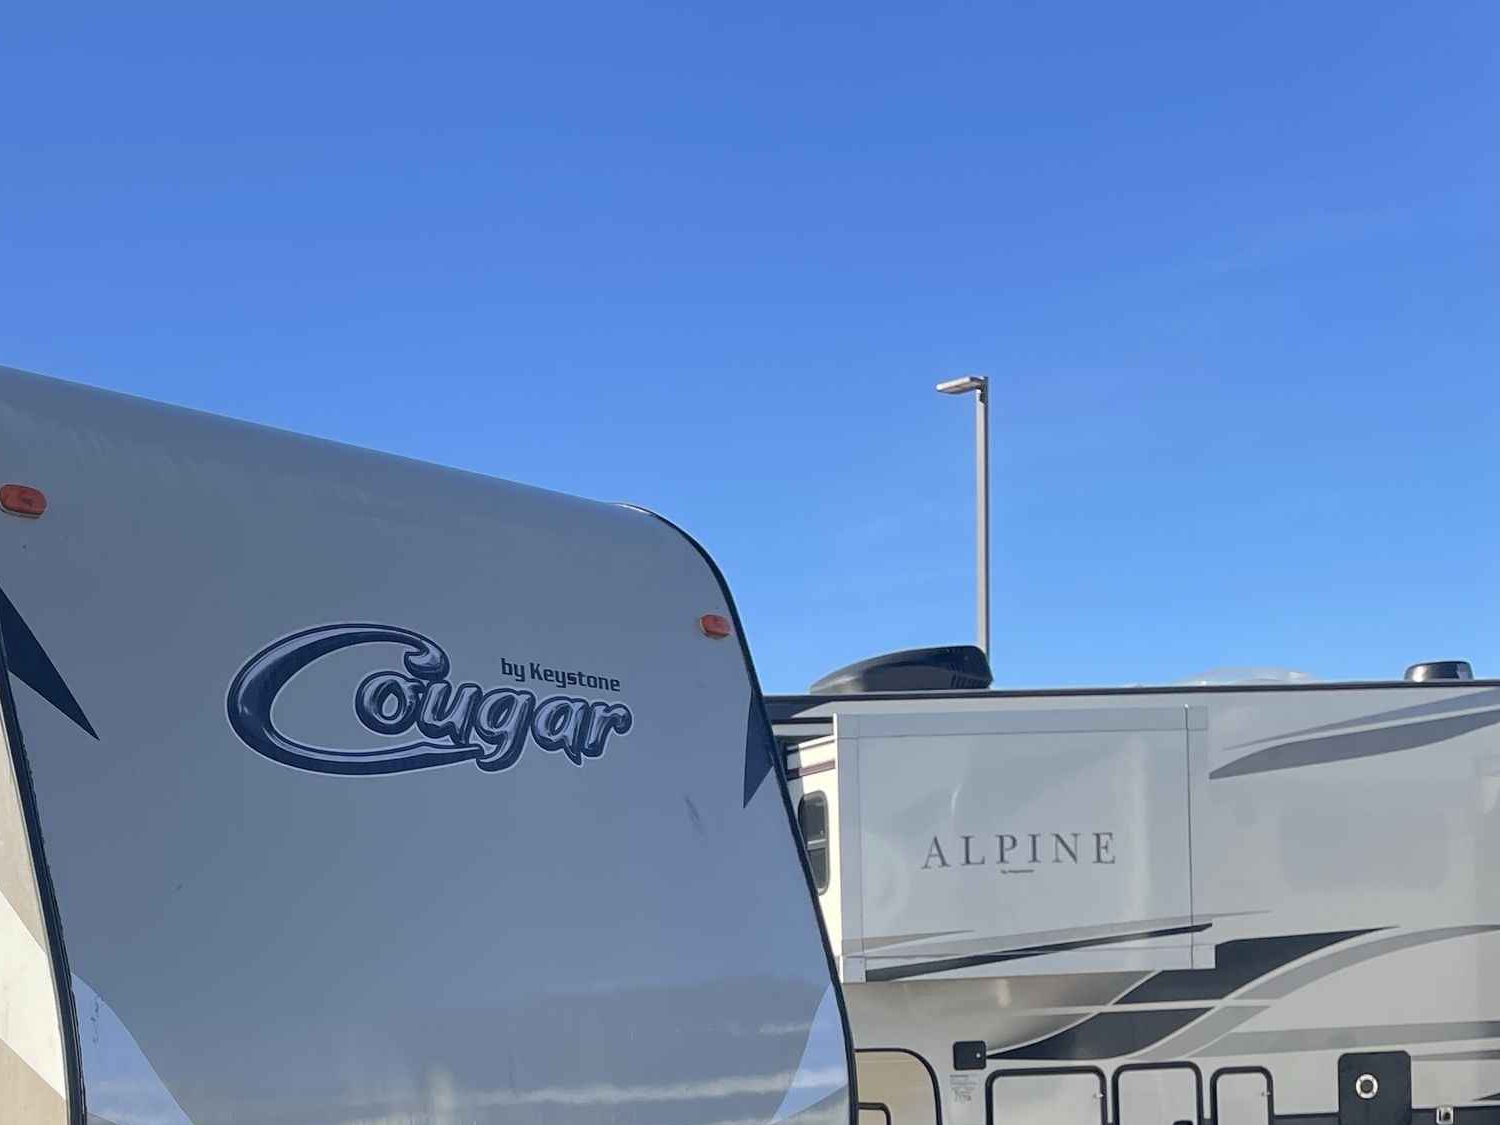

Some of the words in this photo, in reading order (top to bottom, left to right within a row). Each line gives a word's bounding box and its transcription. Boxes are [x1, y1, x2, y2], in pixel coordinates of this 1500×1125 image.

[501, 658, 525, 682] by
[529, 662, 621, 692] Keystone
[226, 622, 632, 776] Cougar
[921, 832, 1116, 869] ALPINE
